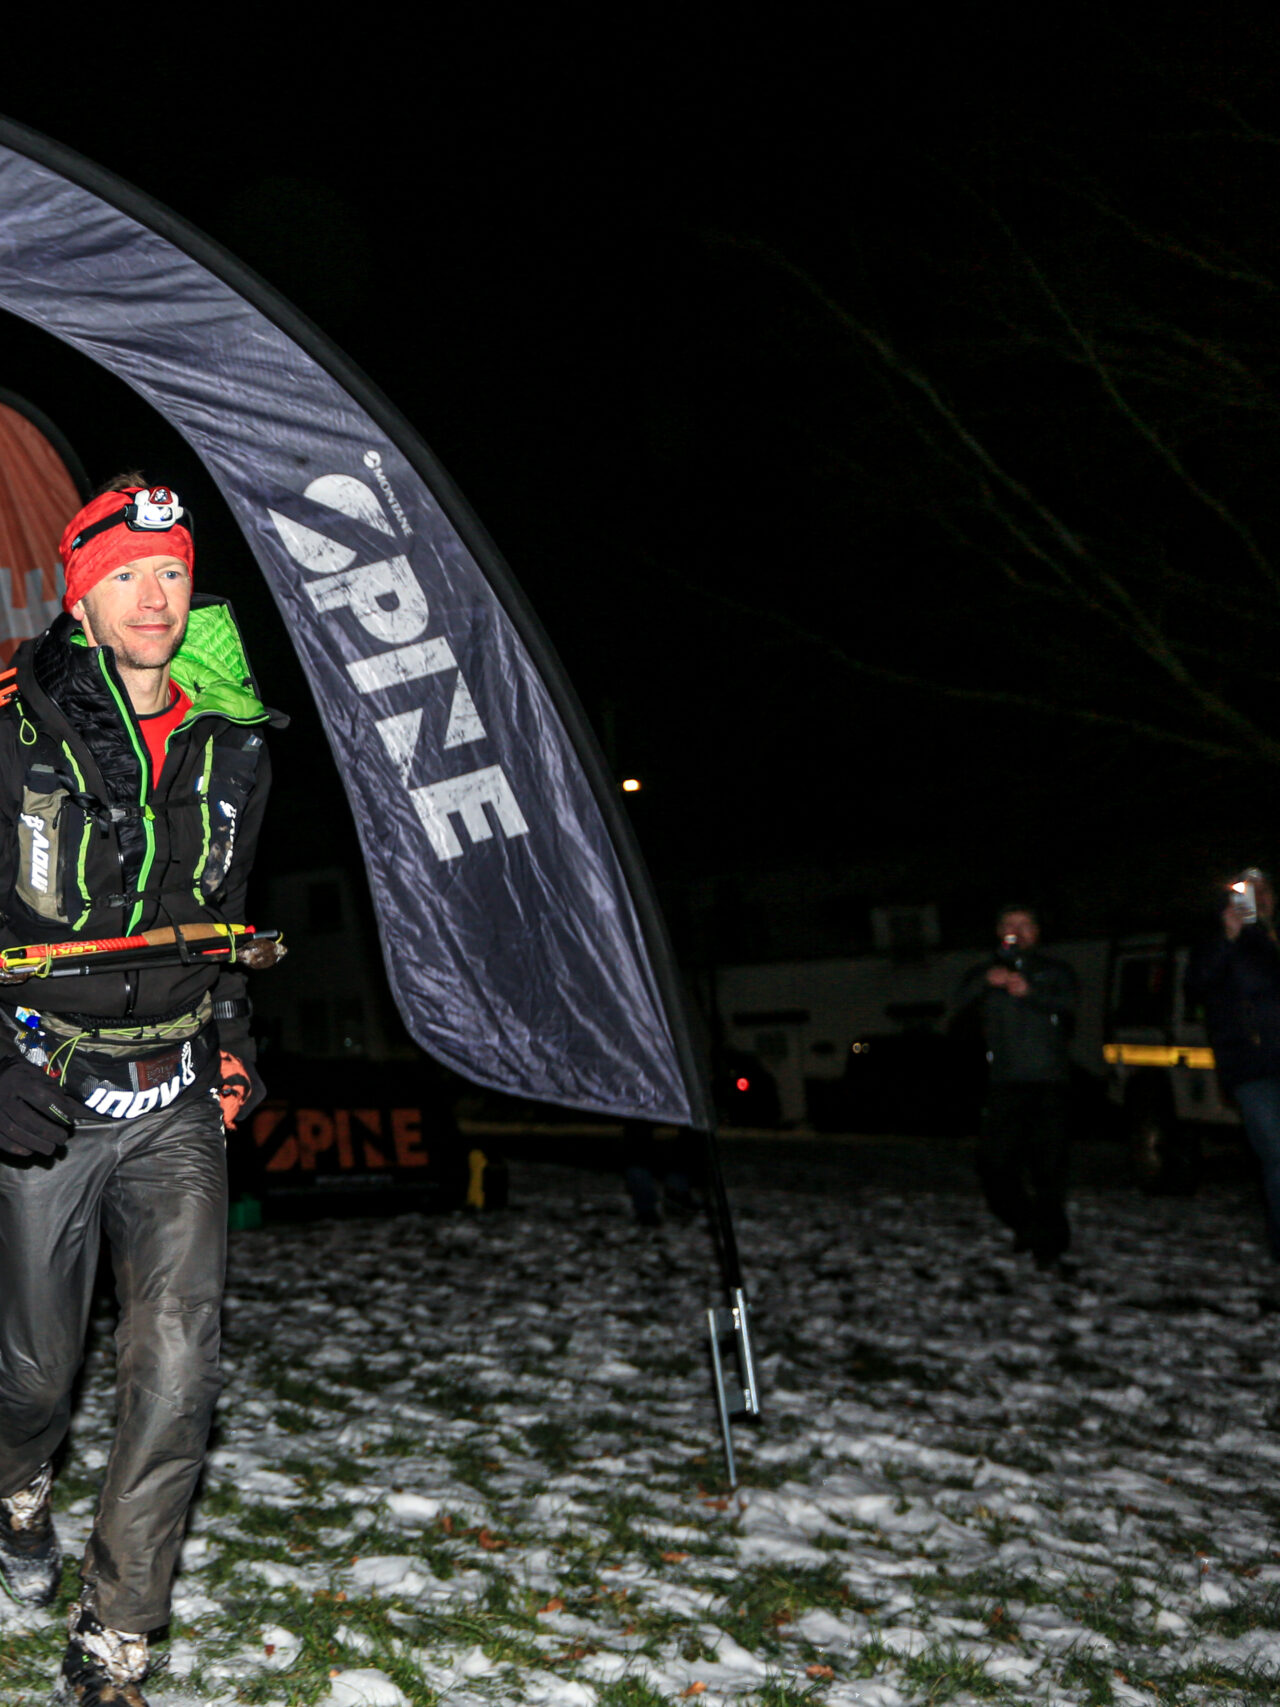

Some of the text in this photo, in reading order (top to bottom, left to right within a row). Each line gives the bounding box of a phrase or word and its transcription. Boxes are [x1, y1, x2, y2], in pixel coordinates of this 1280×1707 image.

[373, 467, 416, 537] MONTANE
[267, 473, 530, 862] SPINE
[251, 1106, 431, 1172] SPINE
